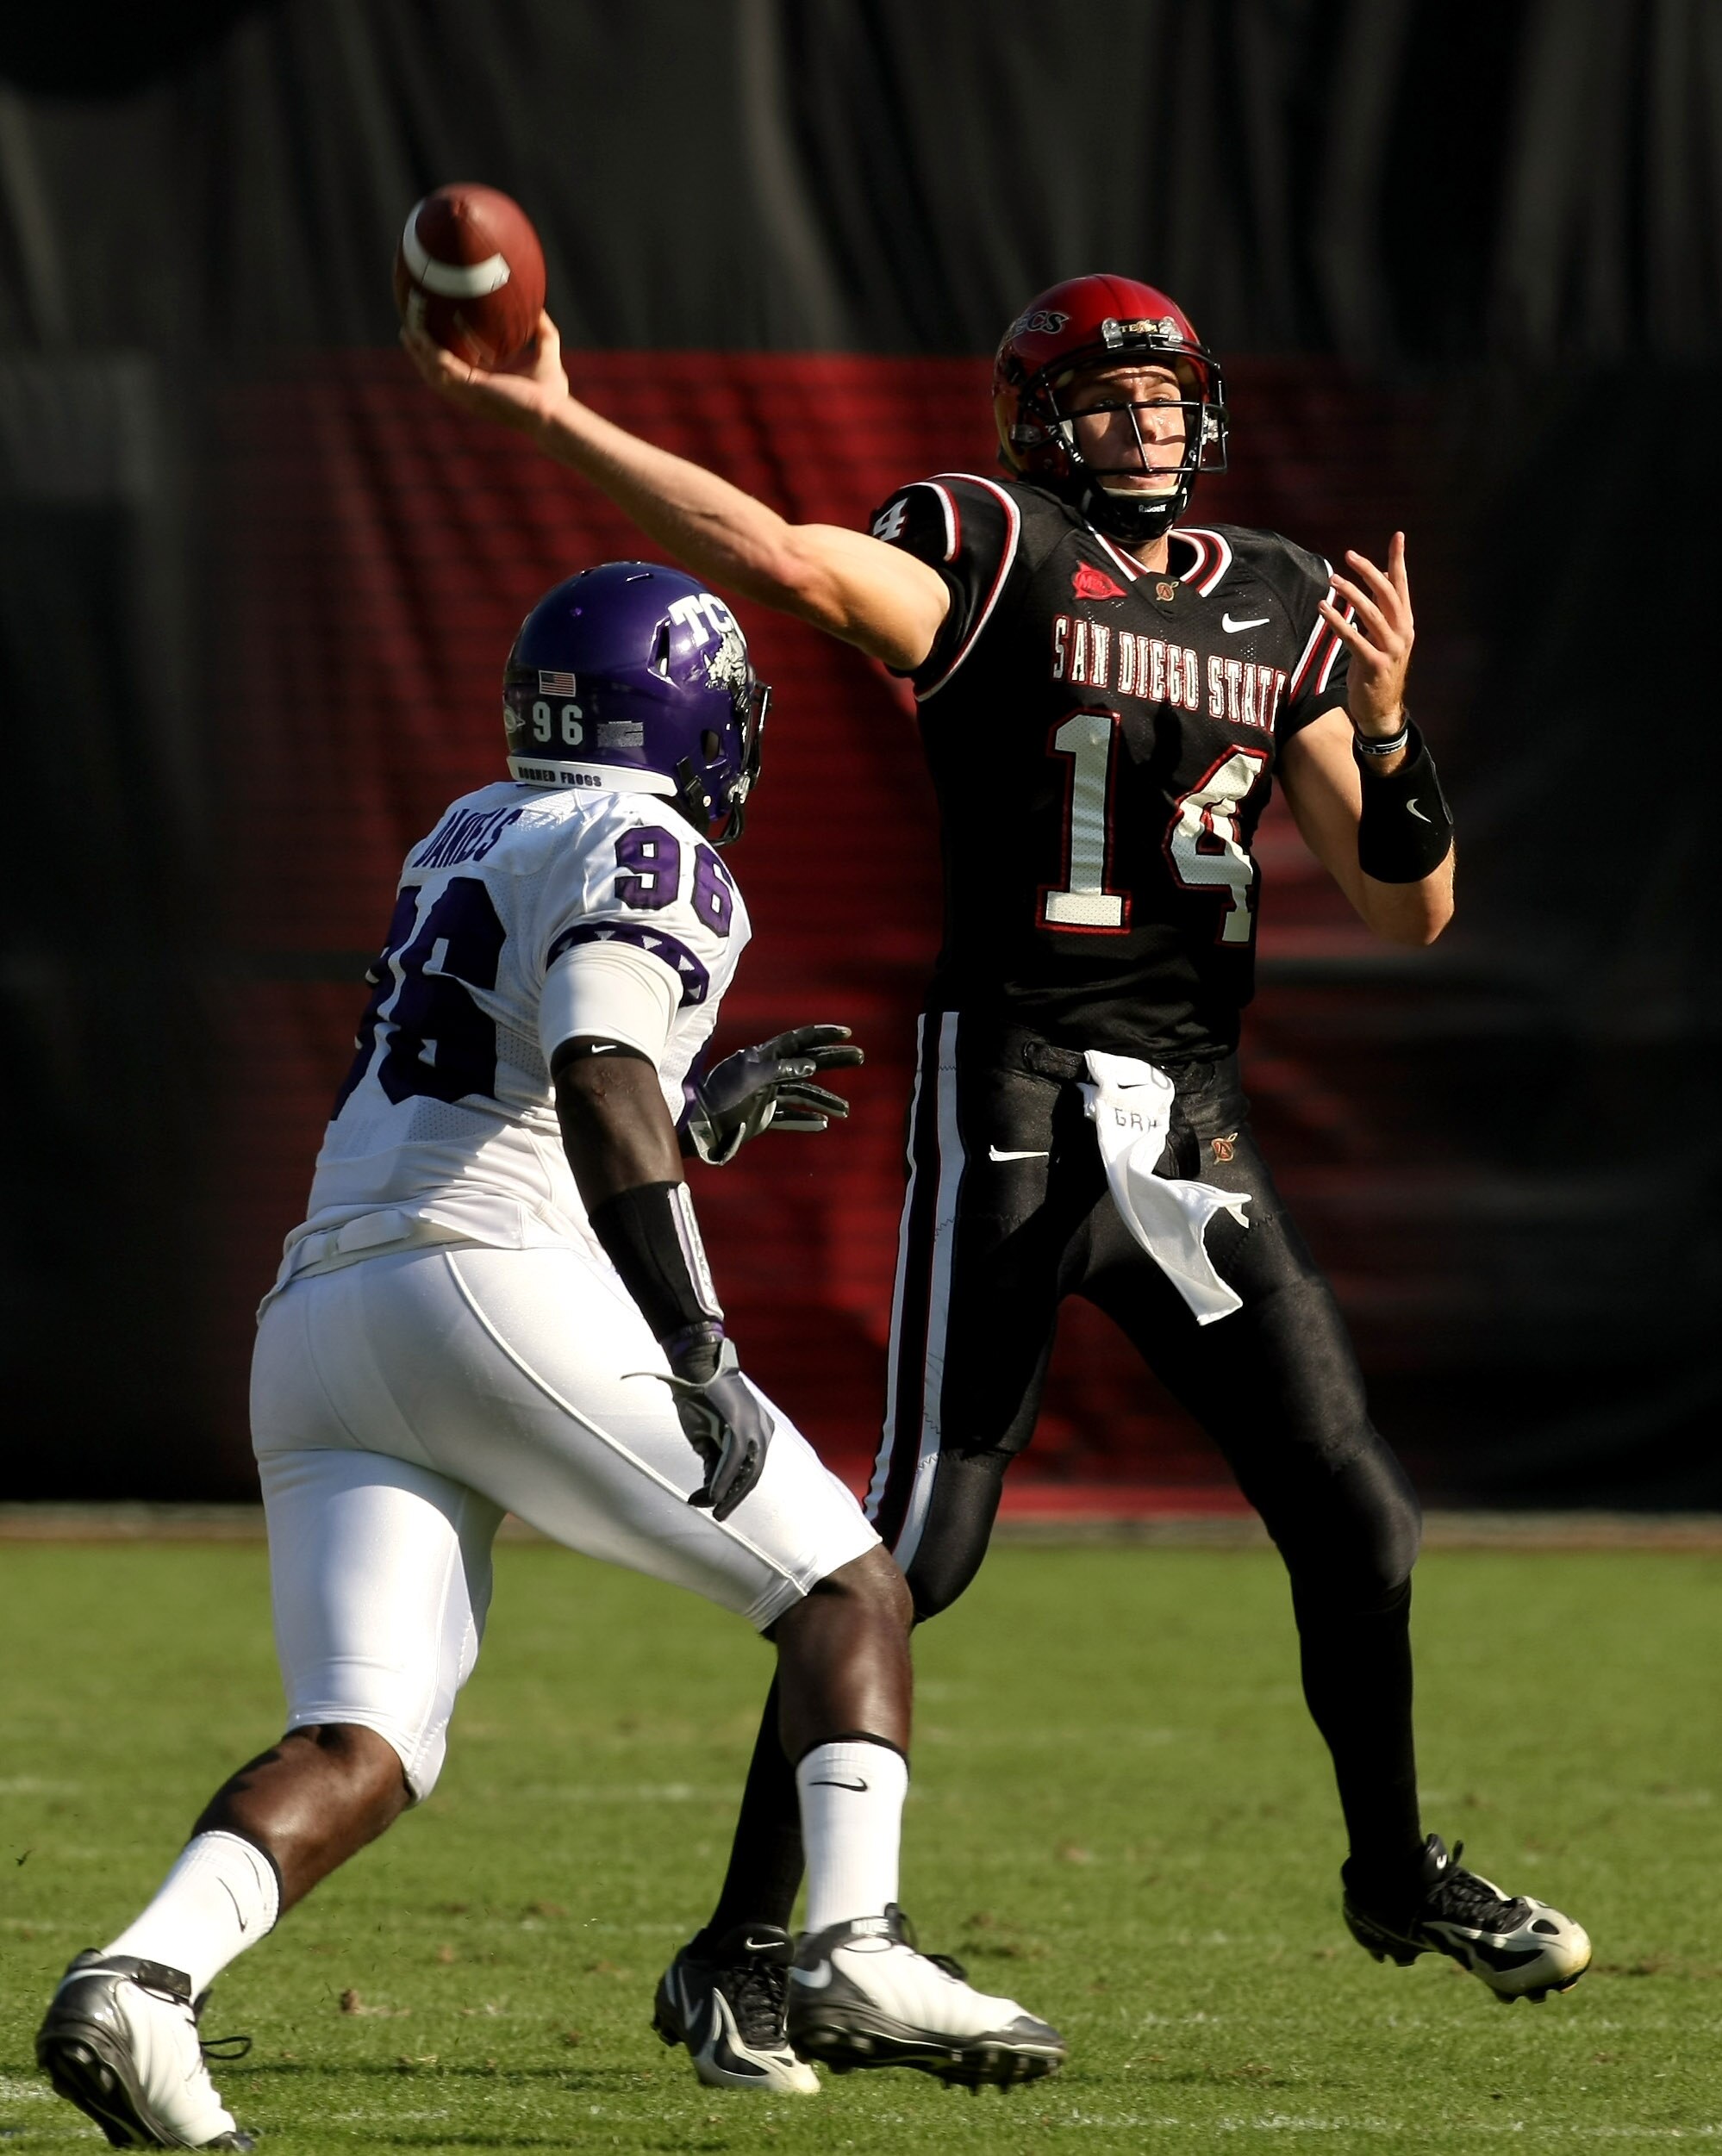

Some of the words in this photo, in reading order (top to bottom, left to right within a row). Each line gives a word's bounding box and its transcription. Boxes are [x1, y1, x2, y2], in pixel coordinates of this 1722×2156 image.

[667, 593, 748, 648] TC
[1051, 614, 1112, 688] SAN
[1118, 631, 1200, 712] DIEGO
[532, 701, 583, 746] 96
[560, 771, 602, 788] FROGS
[1036, 707, 1270, 947] 14
[614, 826, 734, 938] 96
